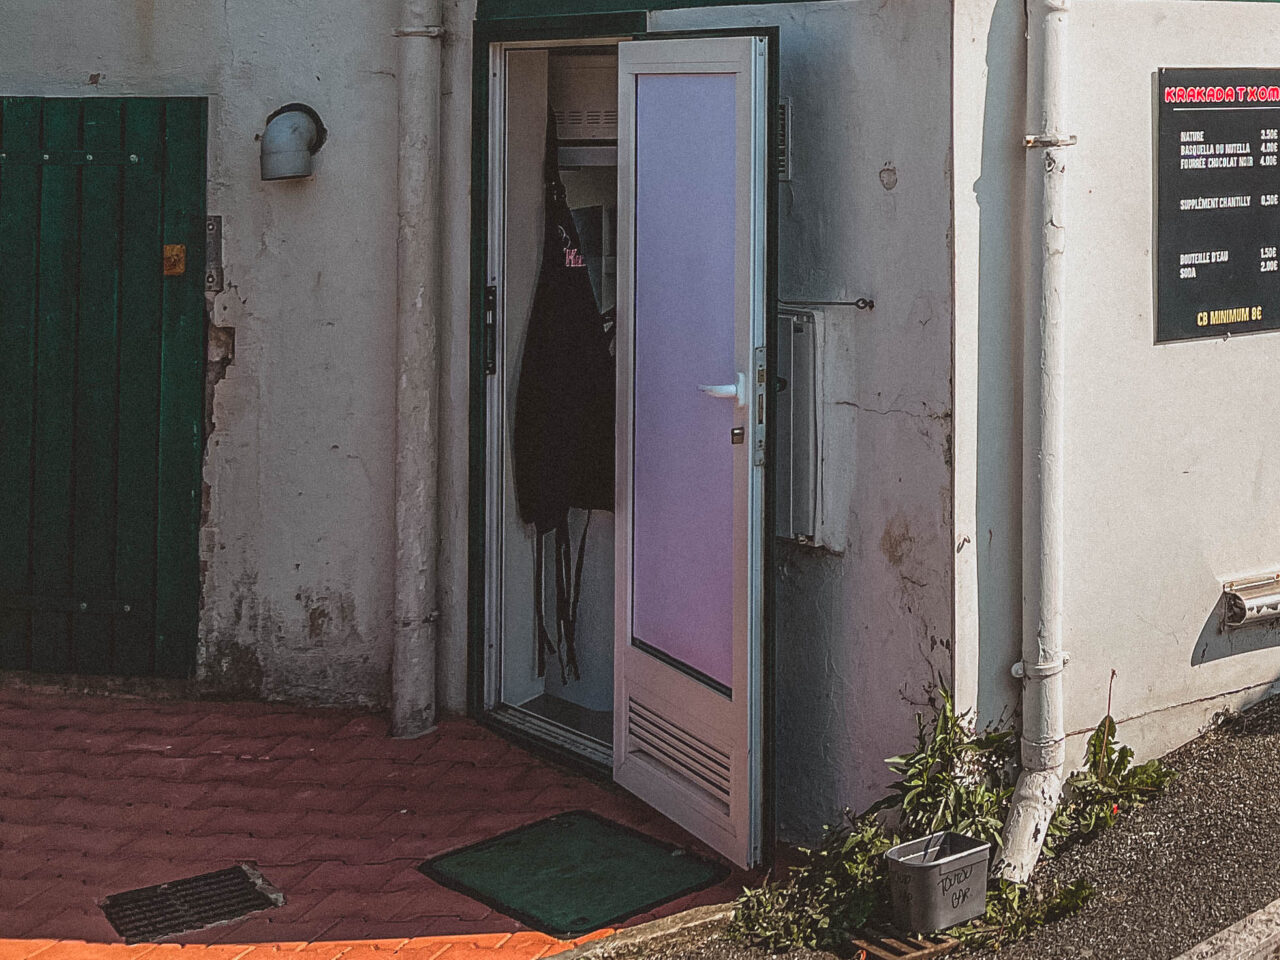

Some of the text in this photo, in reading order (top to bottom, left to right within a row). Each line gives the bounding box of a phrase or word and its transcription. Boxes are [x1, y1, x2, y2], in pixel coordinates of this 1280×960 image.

[1165, 87, 1234, 102] KRAKADA
[1181, 131, 1204, 142] NATURE
[1181, 144, 1214, 156] BASQUELLA
[1208, 157, 1237, 168] CHOCOLAT
[1180, 196, 1219, 210] SUPPLÉMENT
[1220, 196, 1250, 208] CHANTILLY
[1180, 252, 1210, 265] BOUTEILLE
[1180, 268, 1196, 279] SODA
[1197, 306, 1262, 326] CB MINIMUM 8€
